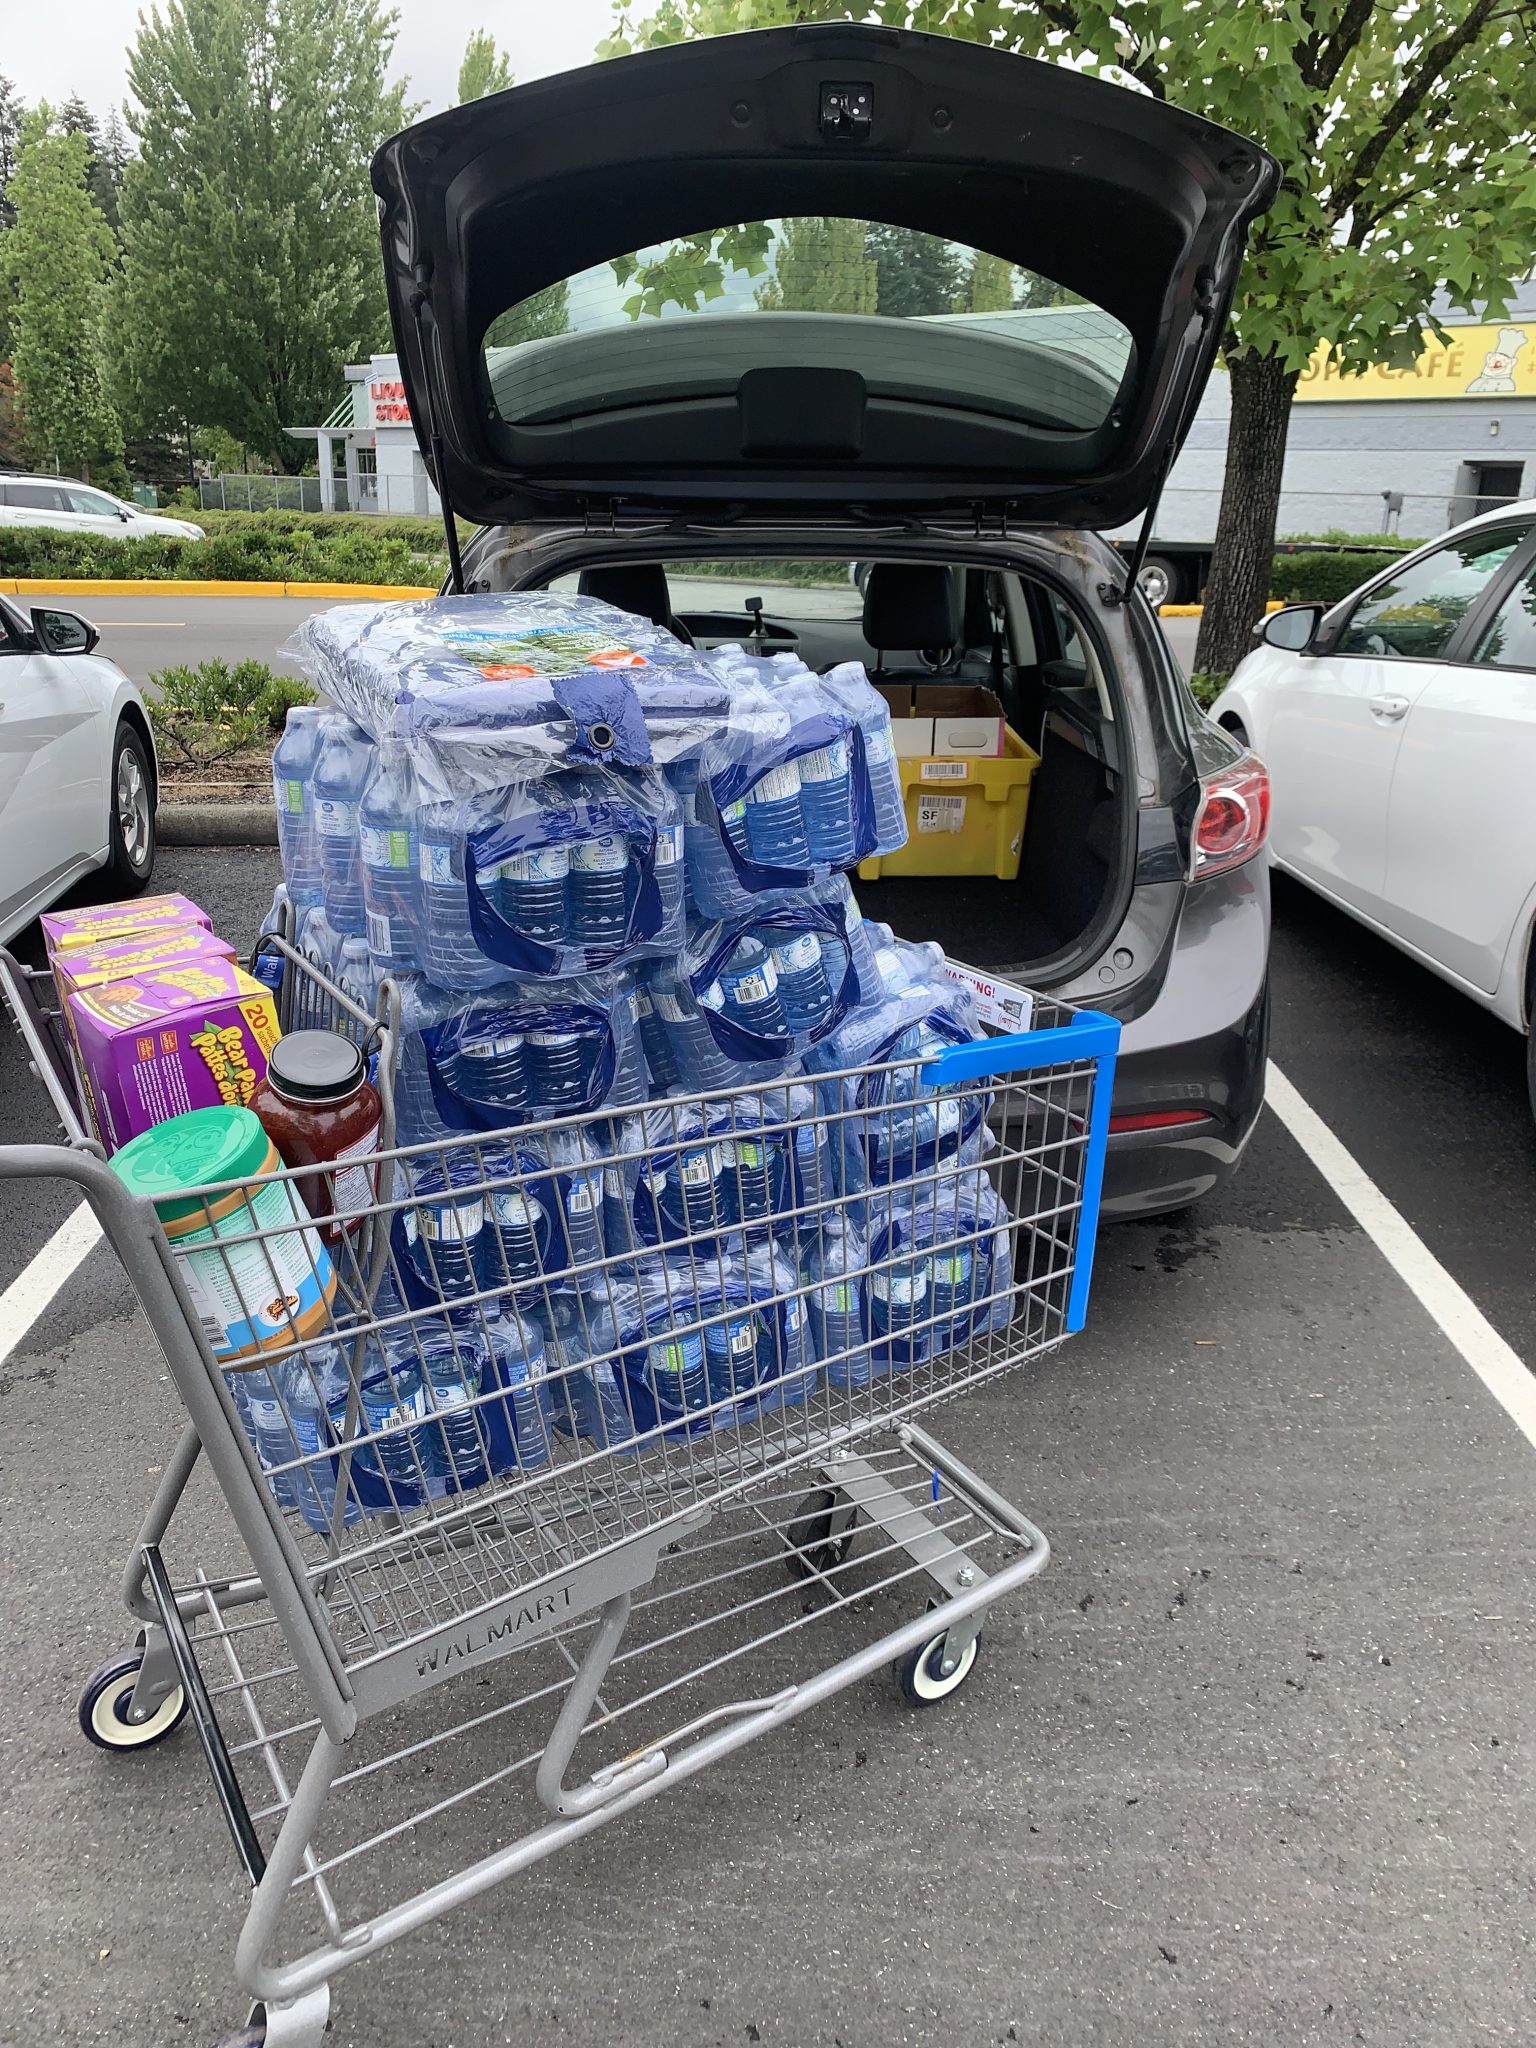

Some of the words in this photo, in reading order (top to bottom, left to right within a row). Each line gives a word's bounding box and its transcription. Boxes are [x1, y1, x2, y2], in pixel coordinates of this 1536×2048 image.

[922, 810, 938, 820] SF
[245, 1003, 269, 1029] 20
[190, 1032, 228, 1081] Pattes
[217, 1026, 249, 1068] Bear
[415, 1583, 576, 1677] WALMART
